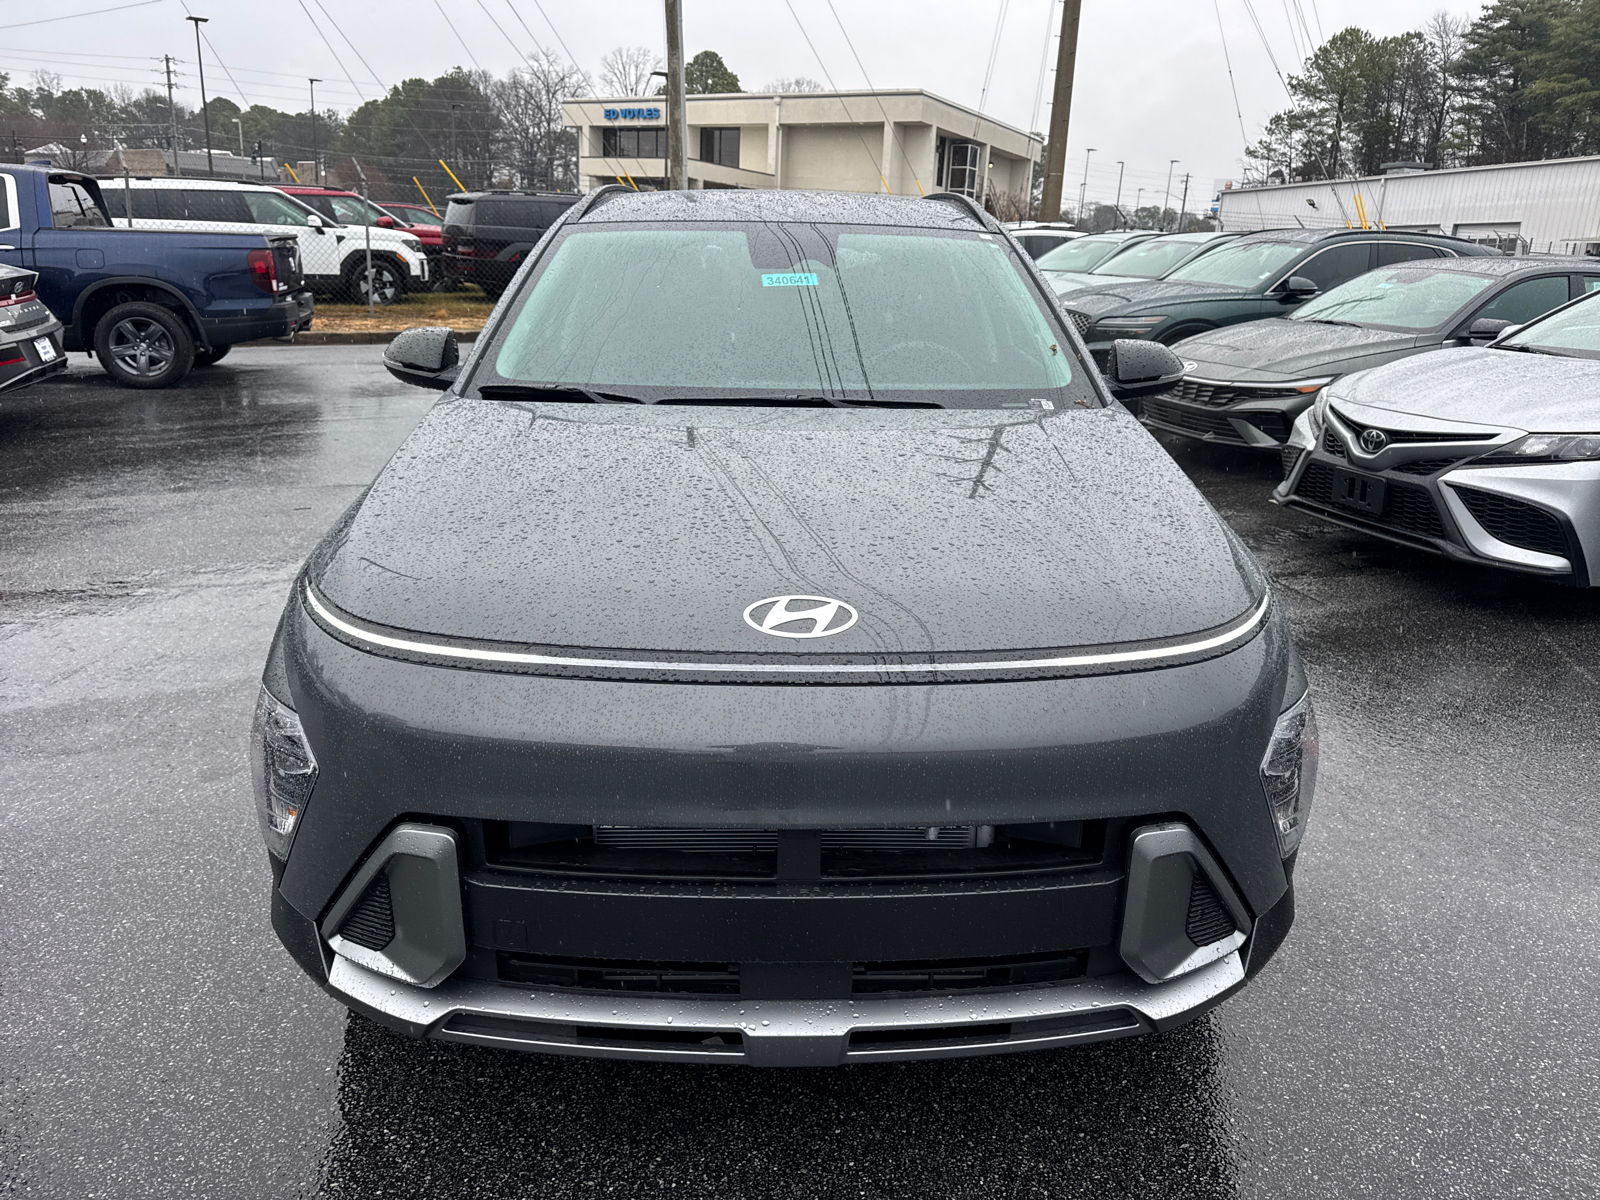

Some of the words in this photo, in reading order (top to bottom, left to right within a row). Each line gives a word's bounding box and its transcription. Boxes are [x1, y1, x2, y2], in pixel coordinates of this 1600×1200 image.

[604, 109, 618, 119] ED
[620, 108, 660, 119] VOYLES
[767, 276, 810, 286] 340641
